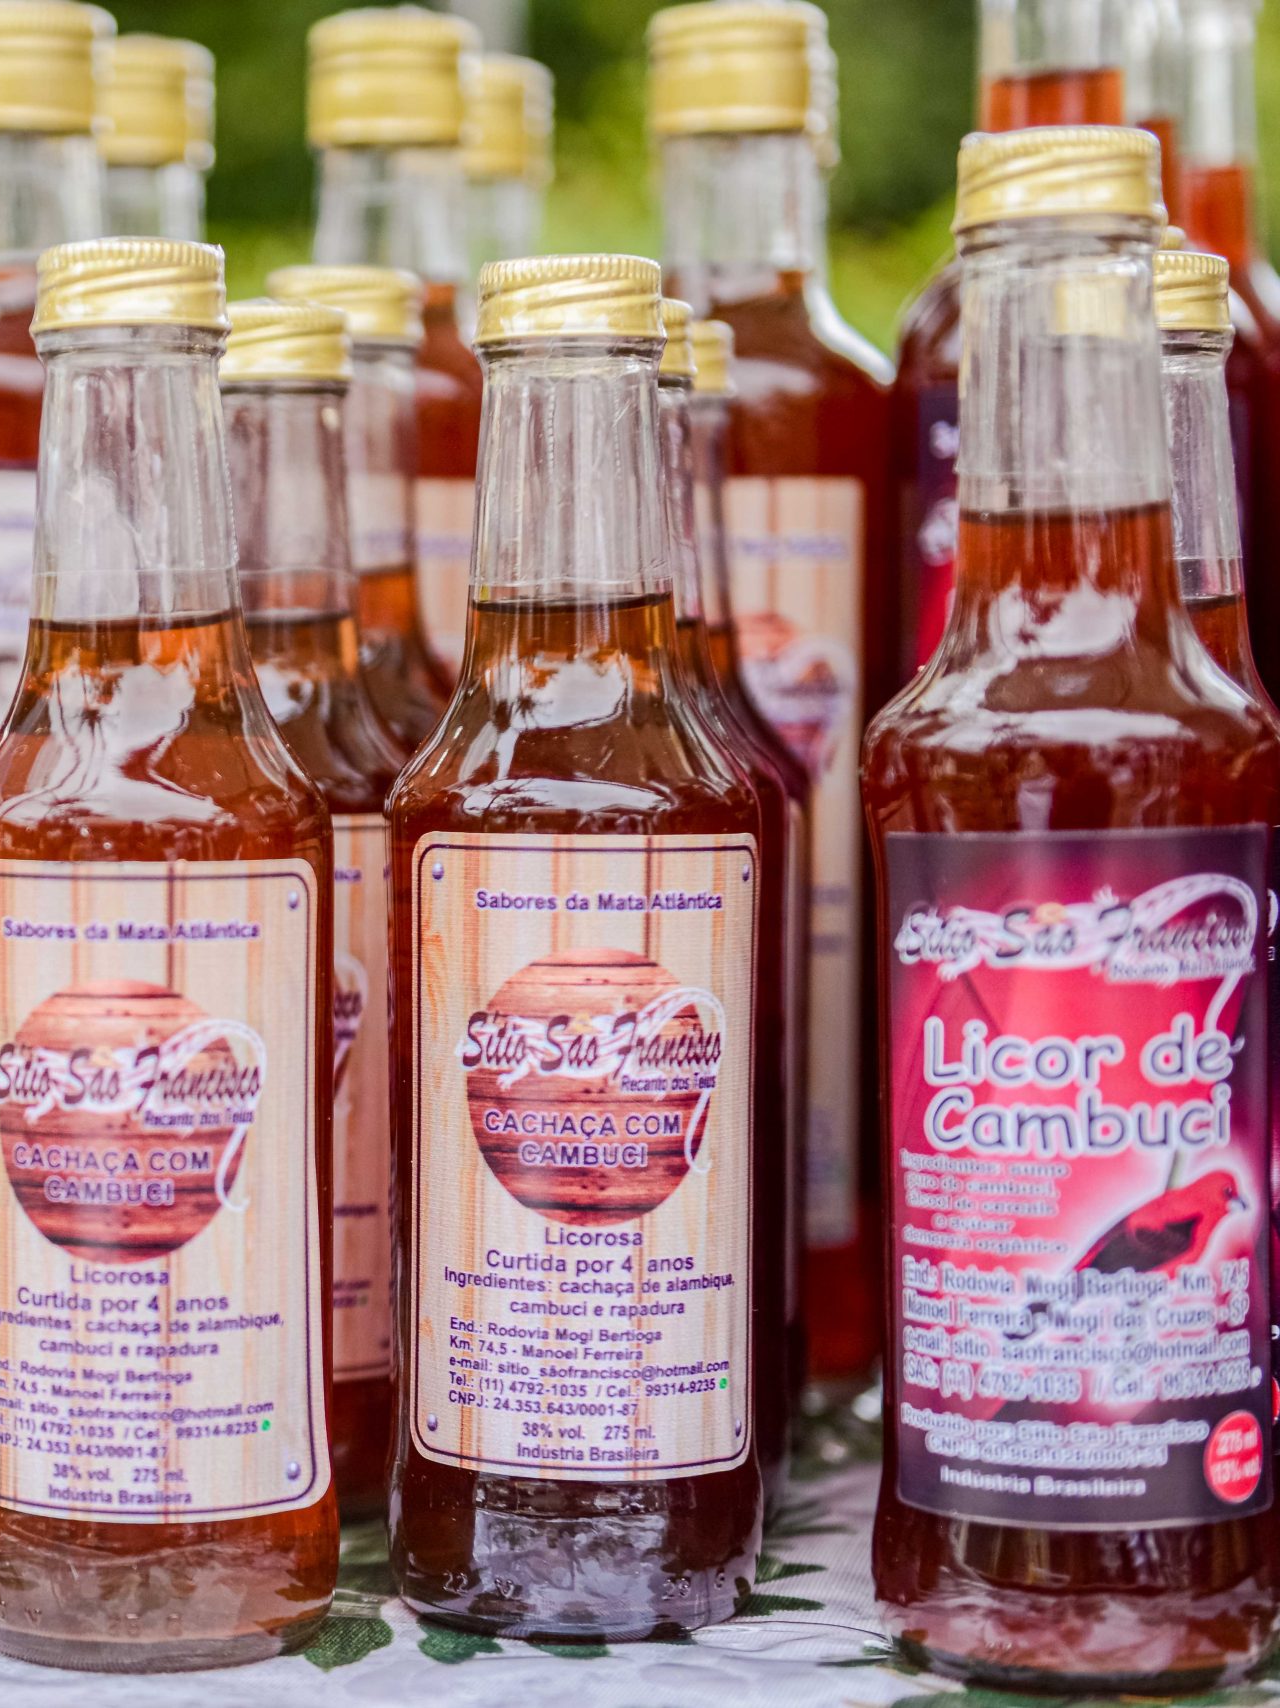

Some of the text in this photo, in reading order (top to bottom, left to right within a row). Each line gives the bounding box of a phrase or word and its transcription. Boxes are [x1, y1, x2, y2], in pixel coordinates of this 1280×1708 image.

[477, 890, 723, 910] Sabores da Mata Atlântica
[3, 920, 260, 940] Sabores da Mata Atlântica
[611, 1012, 722, 1081] Francisco
[927, 1016, 1242, 1083] Licor de
[134, 1046, 260, 1114] Francisco
[622, 1075, 667, 1092] Recanto
[671, 1077, 689, 1091] dos
[485, 1112, 680, 1140] CACHAÇA COM
[928, 1083, 1228, 1153] Cambuci
[14, 1145, 211, 1177] CACHAÇA COM
[521, 1144, 647, 1165] CAMBUCI
[48, 1180, 174, 1204] CAMBUCI
[545, 1227, 643, 1246] Licorosa
[486, 1250, 694, 1276] Curtida por 4 anos
[70, 1266, 169, 1285] Licorosa
[444, 1267, 735, 1297] Ingredientes: cachaça de alambique,
[942, 1265, 1016, 1295] Rodovia
[1025, 1272, 1077, 1300] Mogi
[17, 1287, 229, 1314] Curtida por 4 anos
[510, 1300, 685, 1320] cambuci e rapadura
[85, 1317, 161, 1336] cachaça
[169, 1318, 190, 1333] de
[197, 1311, 284, 1331] alambique,
[904, 1292, 952, 1322] Manoel
[957, 1301, 1033, 1328] Ferreira
[1054, 1308, 1104, 1334] Mogi
[1113, 1307, 1143, 1329] das
[1155, 1303, 1216, 1328] Cruzes
[450, 1317, 662, 1345] End.: Rodovia Mogi Bertioga
[39, 1337, 219, 1360] cambuci e rapadura
[478, 1340, 507, 1356] 74,5
[522, 1345, 578, 1360] Manoel
[583, 1347, 643, 1361] Ferreira
[20, 1360, 76, 1378] Rodovia
[82, 1368, 119, 1384] Mogi
[126, 1370, 192, 1385] Bertioga
[449, 1356, 493, 1372] e-mail:
[52, 1384, 104, 1400] Manoel
[111, 1388, 172, 1400] Ferreira
[449, 1371, 474, 1388] Tel.:
[479, 1376, 504, 1394] (11)
[509, 1381, 587, 1398] 4792-1035
[606, 1384, 640, 1398] Cel.:
[645, 1378, 716, 1397] 99314-9235
[448, 1390, 639, 1416] CNPJ: 24.353.643/0001-87
[14, 1416, 36, 1434] (11)
[41, 1420, 114, 1439] 4792-1035
[522, 1421, 656, 1440] 38% vol. 275 ml.
[517, 1442, 660, 1462] Indústria Brasileira
[53, 1463, 82, 1479] 38%
[87, 1467, 113, 1482] vol.
[133, 1468, 160, 1483] 275
[1034, 1474, 1146, 1496] Brasileira
[119, 1490, 192, 1504] Brasileira
